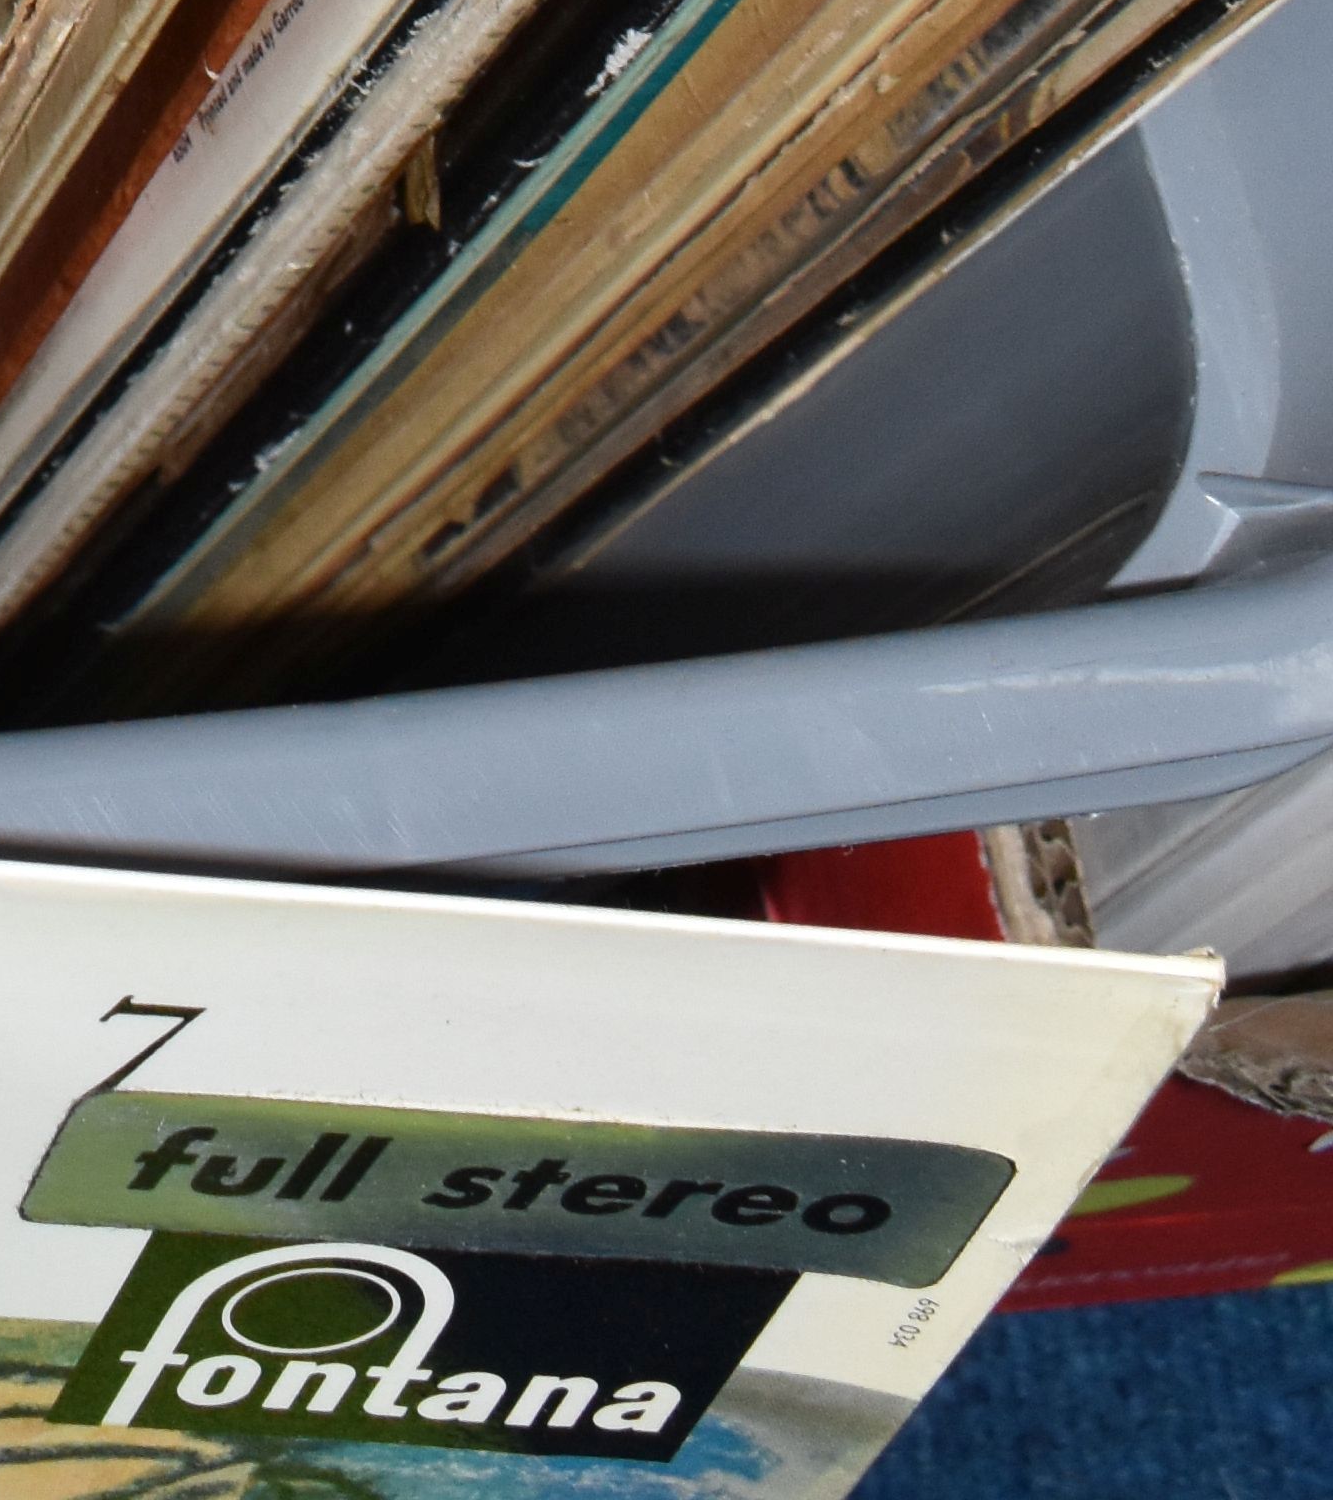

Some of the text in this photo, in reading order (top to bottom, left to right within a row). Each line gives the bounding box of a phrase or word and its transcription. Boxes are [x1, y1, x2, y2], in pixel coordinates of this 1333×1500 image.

[91, 992, 207, 1094] 7
[126, 1125, 896, 1238] full stereo
[103, 1290, 685, 1434] fontana
